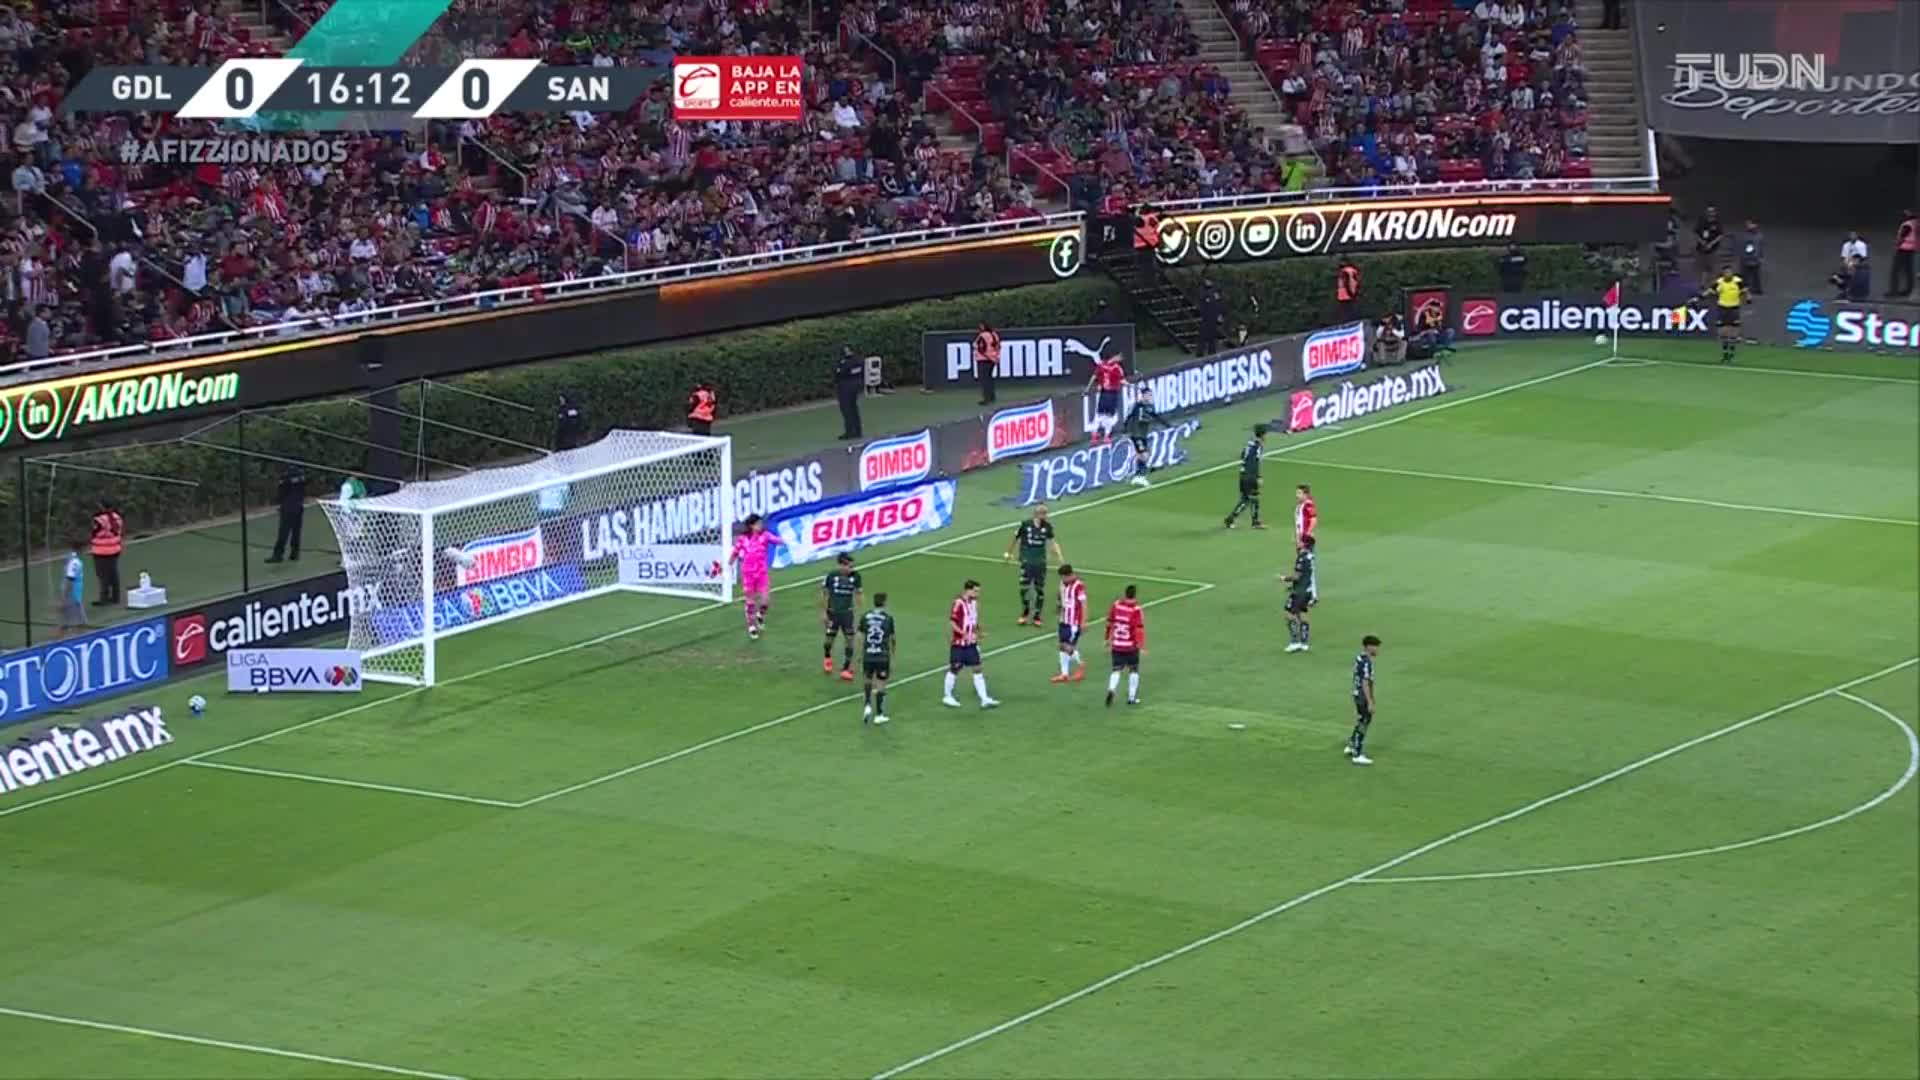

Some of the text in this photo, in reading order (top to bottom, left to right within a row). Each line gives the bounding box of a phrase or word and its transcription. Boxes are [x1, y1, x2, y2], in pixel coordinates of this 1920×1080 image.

[1500, 300, 1708, 331] caliente.mx
[1309, 335, 1360, 369] BIMBO
[1312, 364, 1446, 428] caliente.mx
[993, 411, 1049, 449] BIMBO
[866, 442, 926, 482] BIMBO
[812, 497, 922, 544] BIMBO
[637, 559, 700, 580] BBVA
[230, 653, 269, 668] LIGA
[250, 666, 321, 687] BBVA
[0, 706, 175, 794] iente.mx
